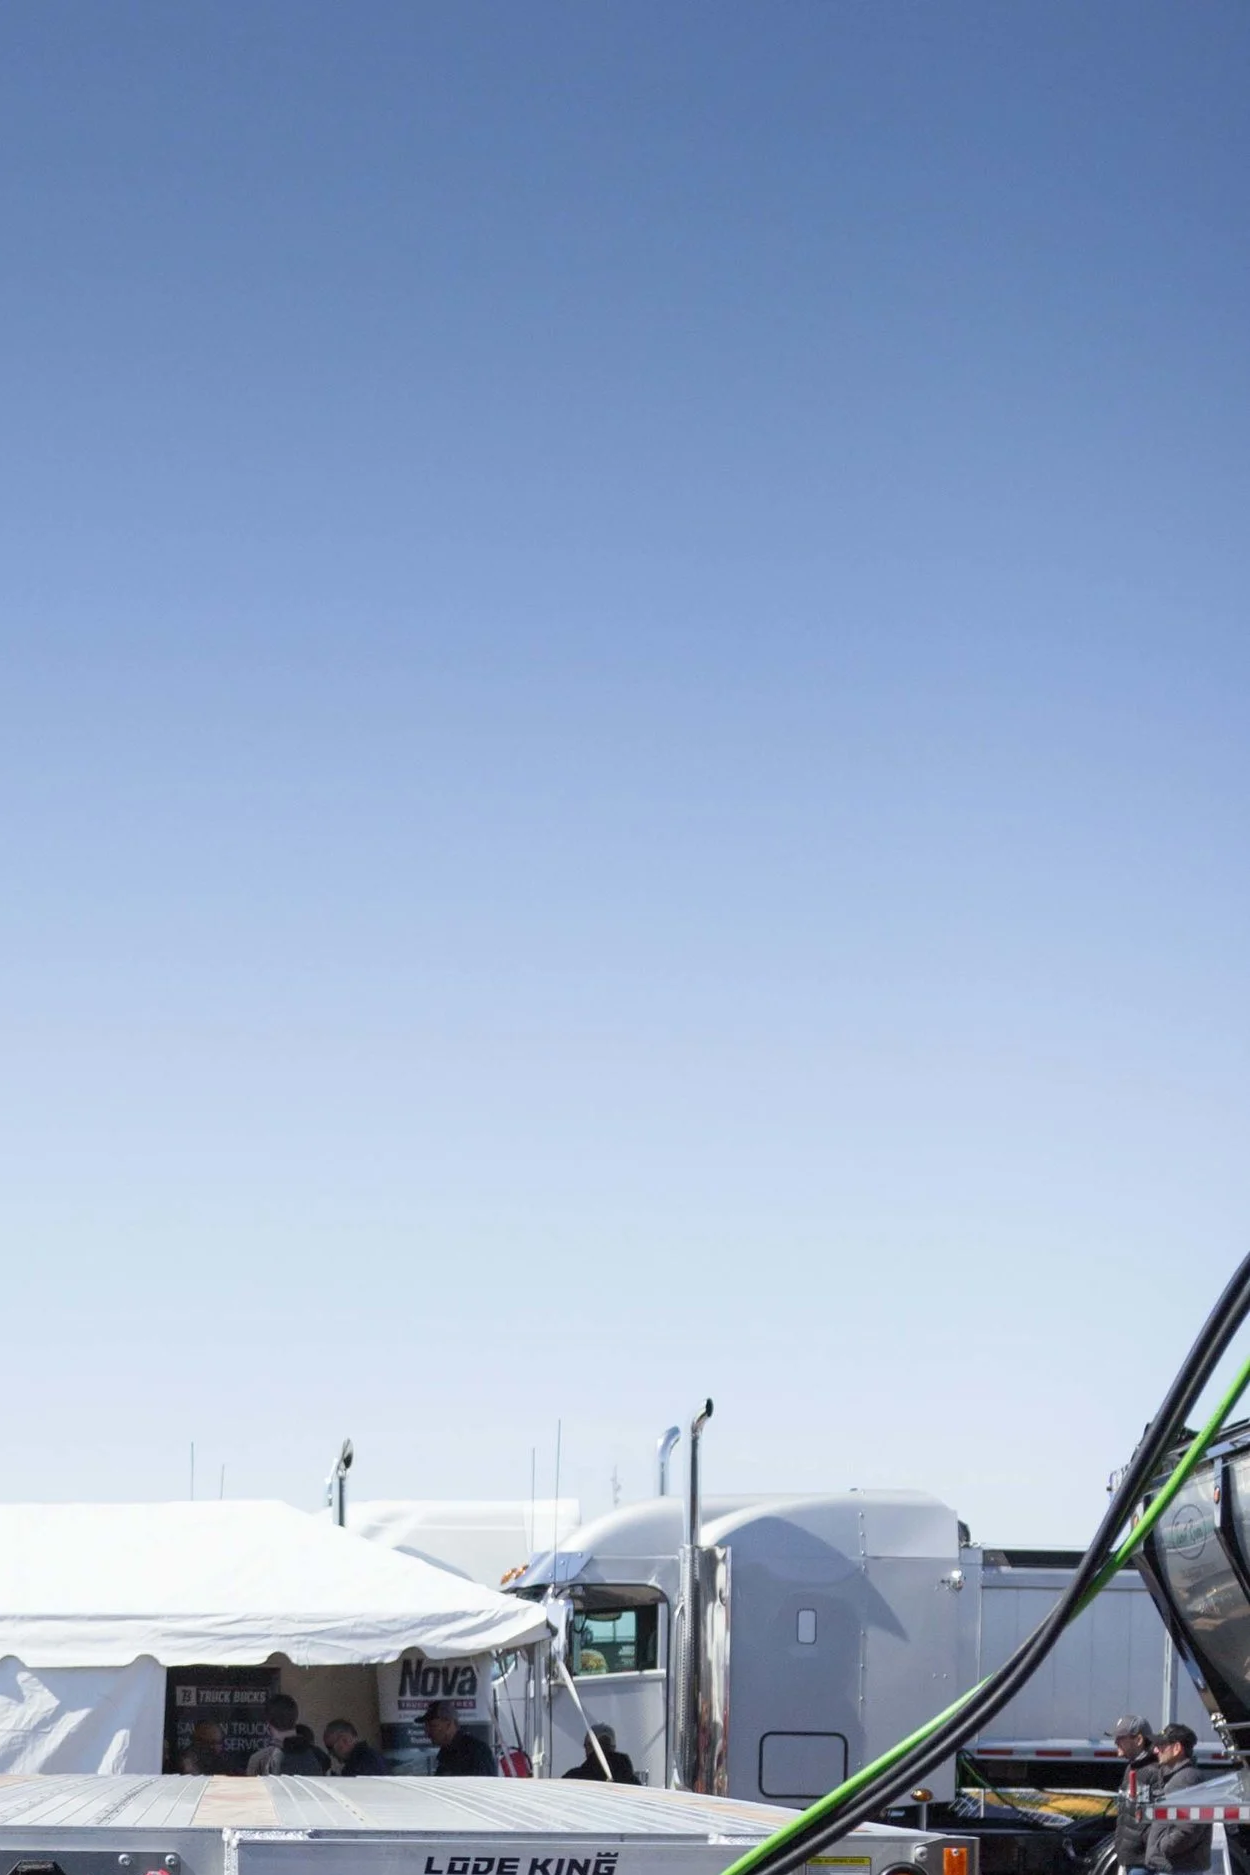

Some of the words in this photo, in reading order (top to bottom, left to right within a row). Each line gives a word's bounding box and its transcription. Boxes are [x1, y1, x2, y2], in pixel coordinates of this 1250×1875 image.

[398, 1659, 478, 1697] Nova
[199, 1689, 230, 1703] TRUCK
[233, 1689, 268, 1703] BUCKS
[424, 1856, 520, 1875] LODE
